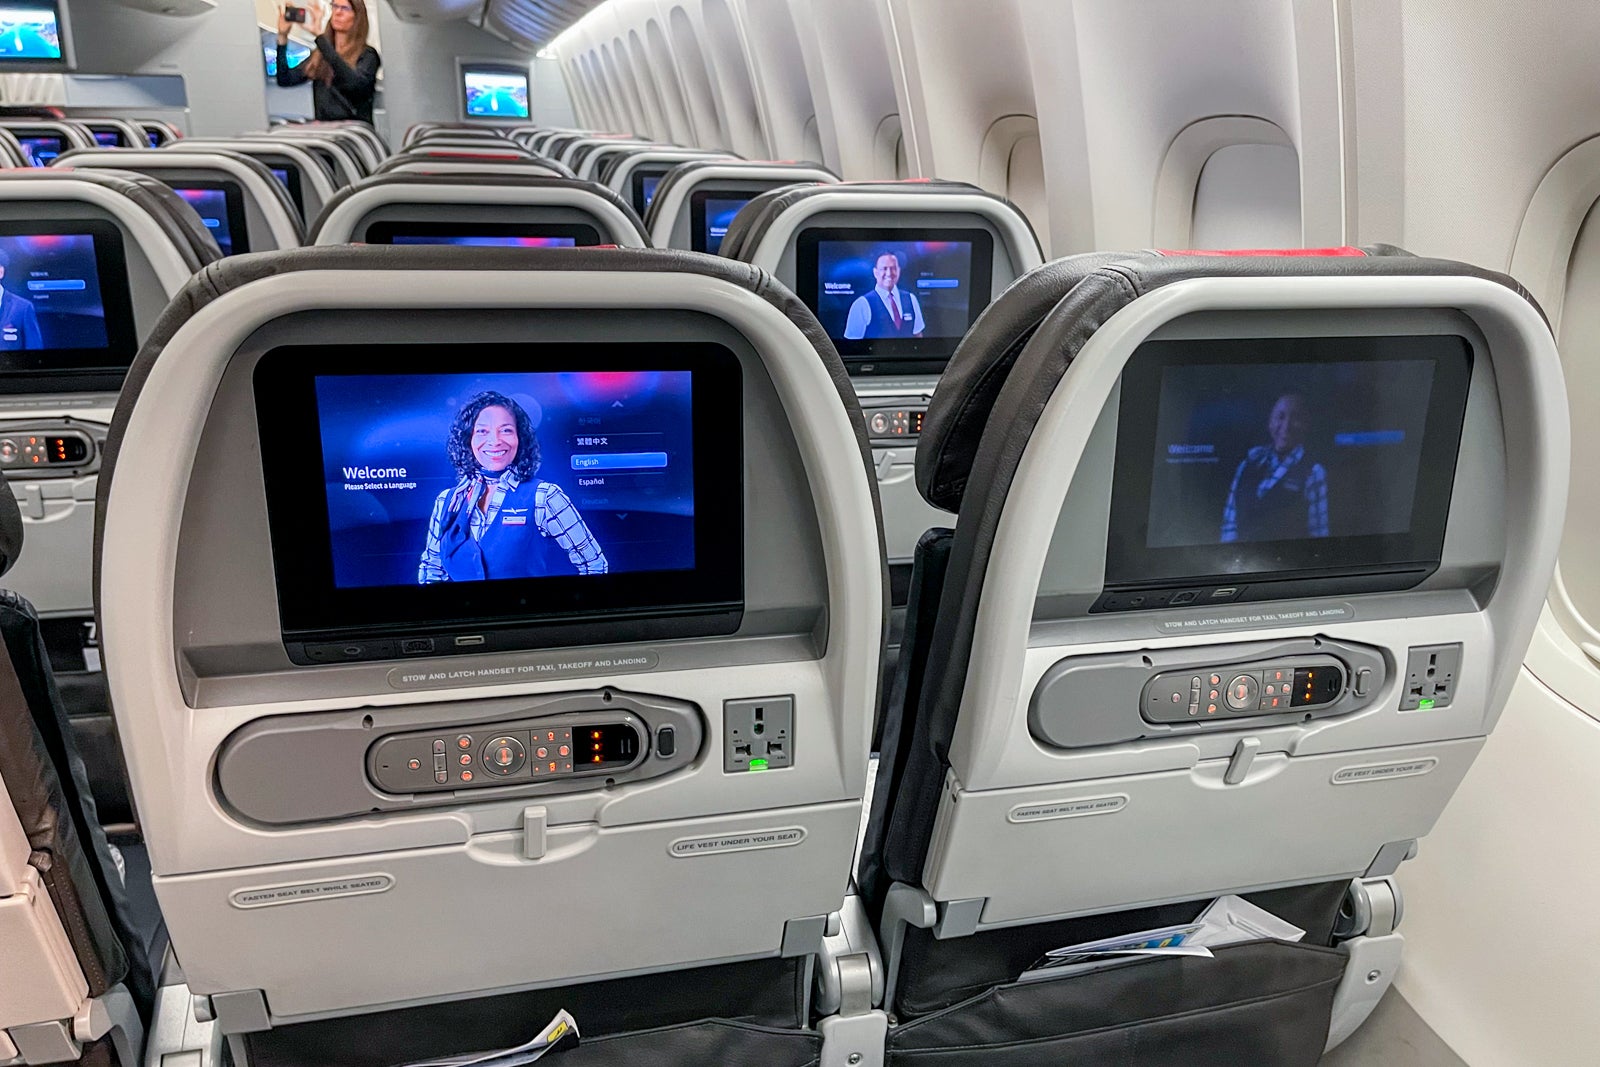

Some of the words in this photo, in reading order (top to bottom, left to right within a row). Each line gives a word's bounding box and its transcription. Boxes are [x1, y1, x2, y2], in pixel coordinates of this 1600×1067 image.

[575, 459, 599, 467] English
[343, 466, 407, 479] Welcome
[388, 482, 417, 490] Language
[578, 478, 605, 487] Español
[1198, 618, 1219, 626] LATCH
[448, 670, 476, 679] LATCH
[477, 667, 515, 676] HANDSET
[517, 665, 534, 673] FOR
[536, 664, 556, 672] TAXI,
[558, 661, 593, 670] TAKEOFF
[613, 657, 647, 665] LANDING
[677, 843, 695, 851] LIFE
[720, 838, 750, 846] UNDER
[752, 835, 775, 843] YOUR
[350, 880, 382, 888] SEATED
